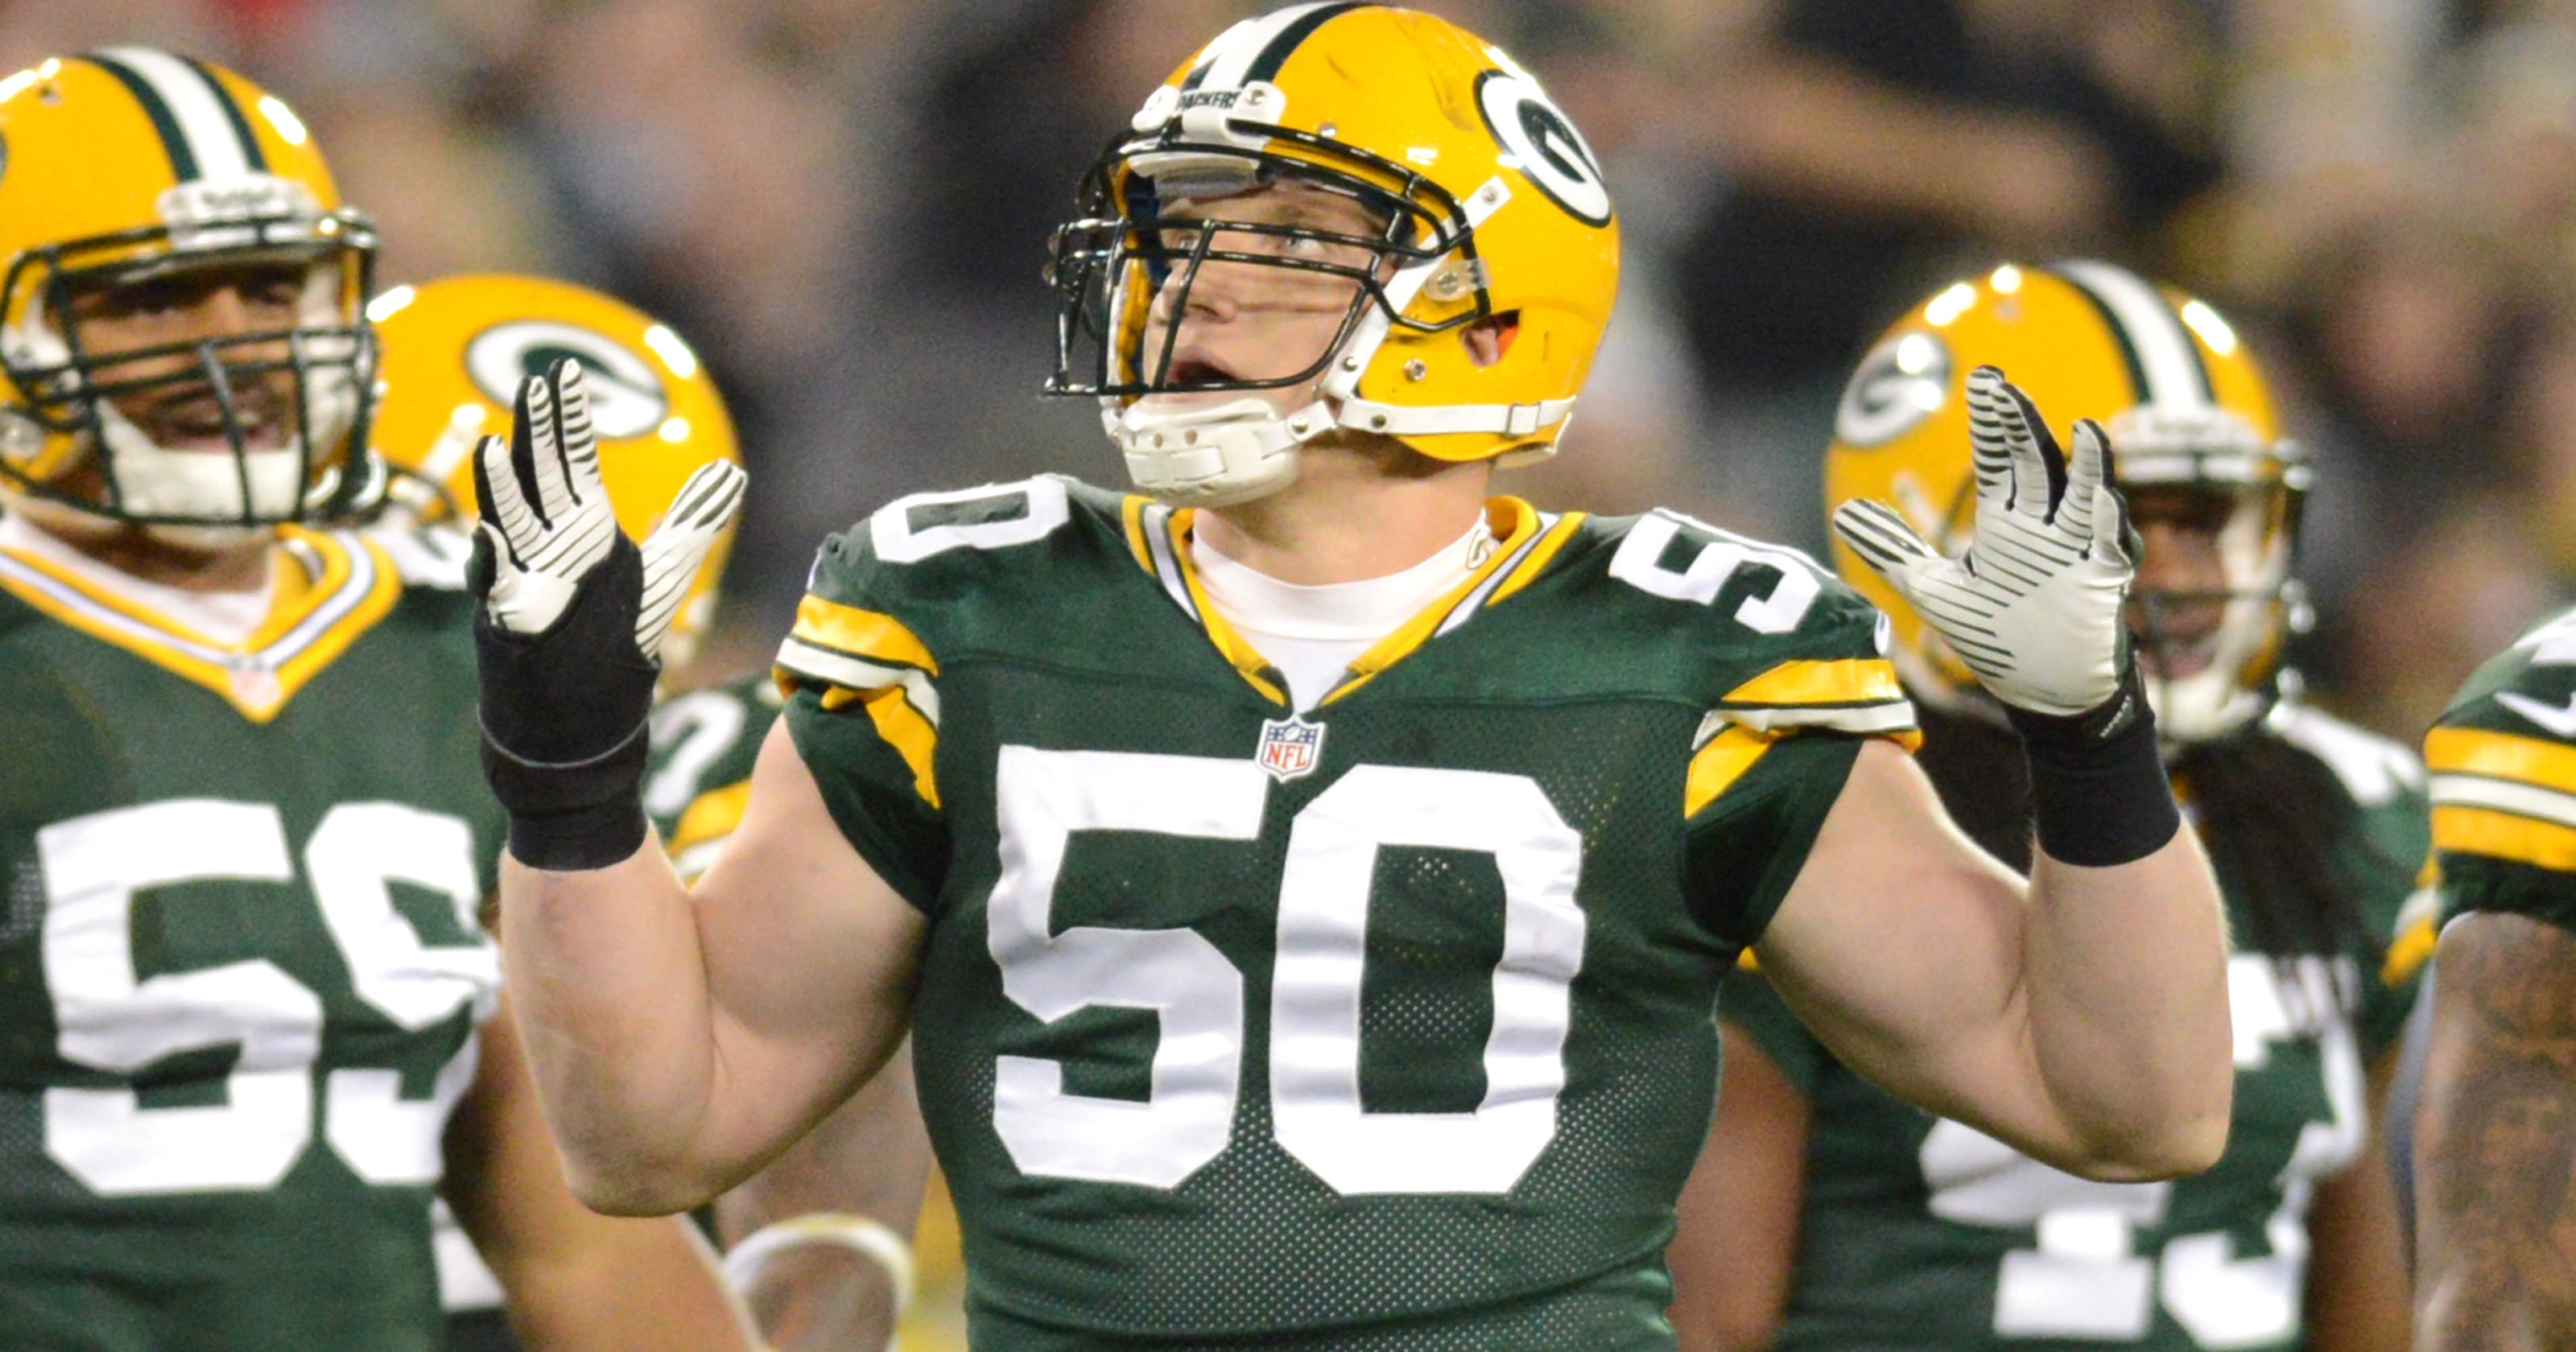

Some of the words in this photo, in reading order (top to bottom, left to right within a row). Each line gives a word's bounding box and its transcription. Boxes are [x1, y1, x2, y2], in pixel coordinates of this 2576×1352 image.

[1266, 744, 1308, 769] NFL
[36, 798, 502, 1196] 59
[988, 745, 1586, 1195] 50
